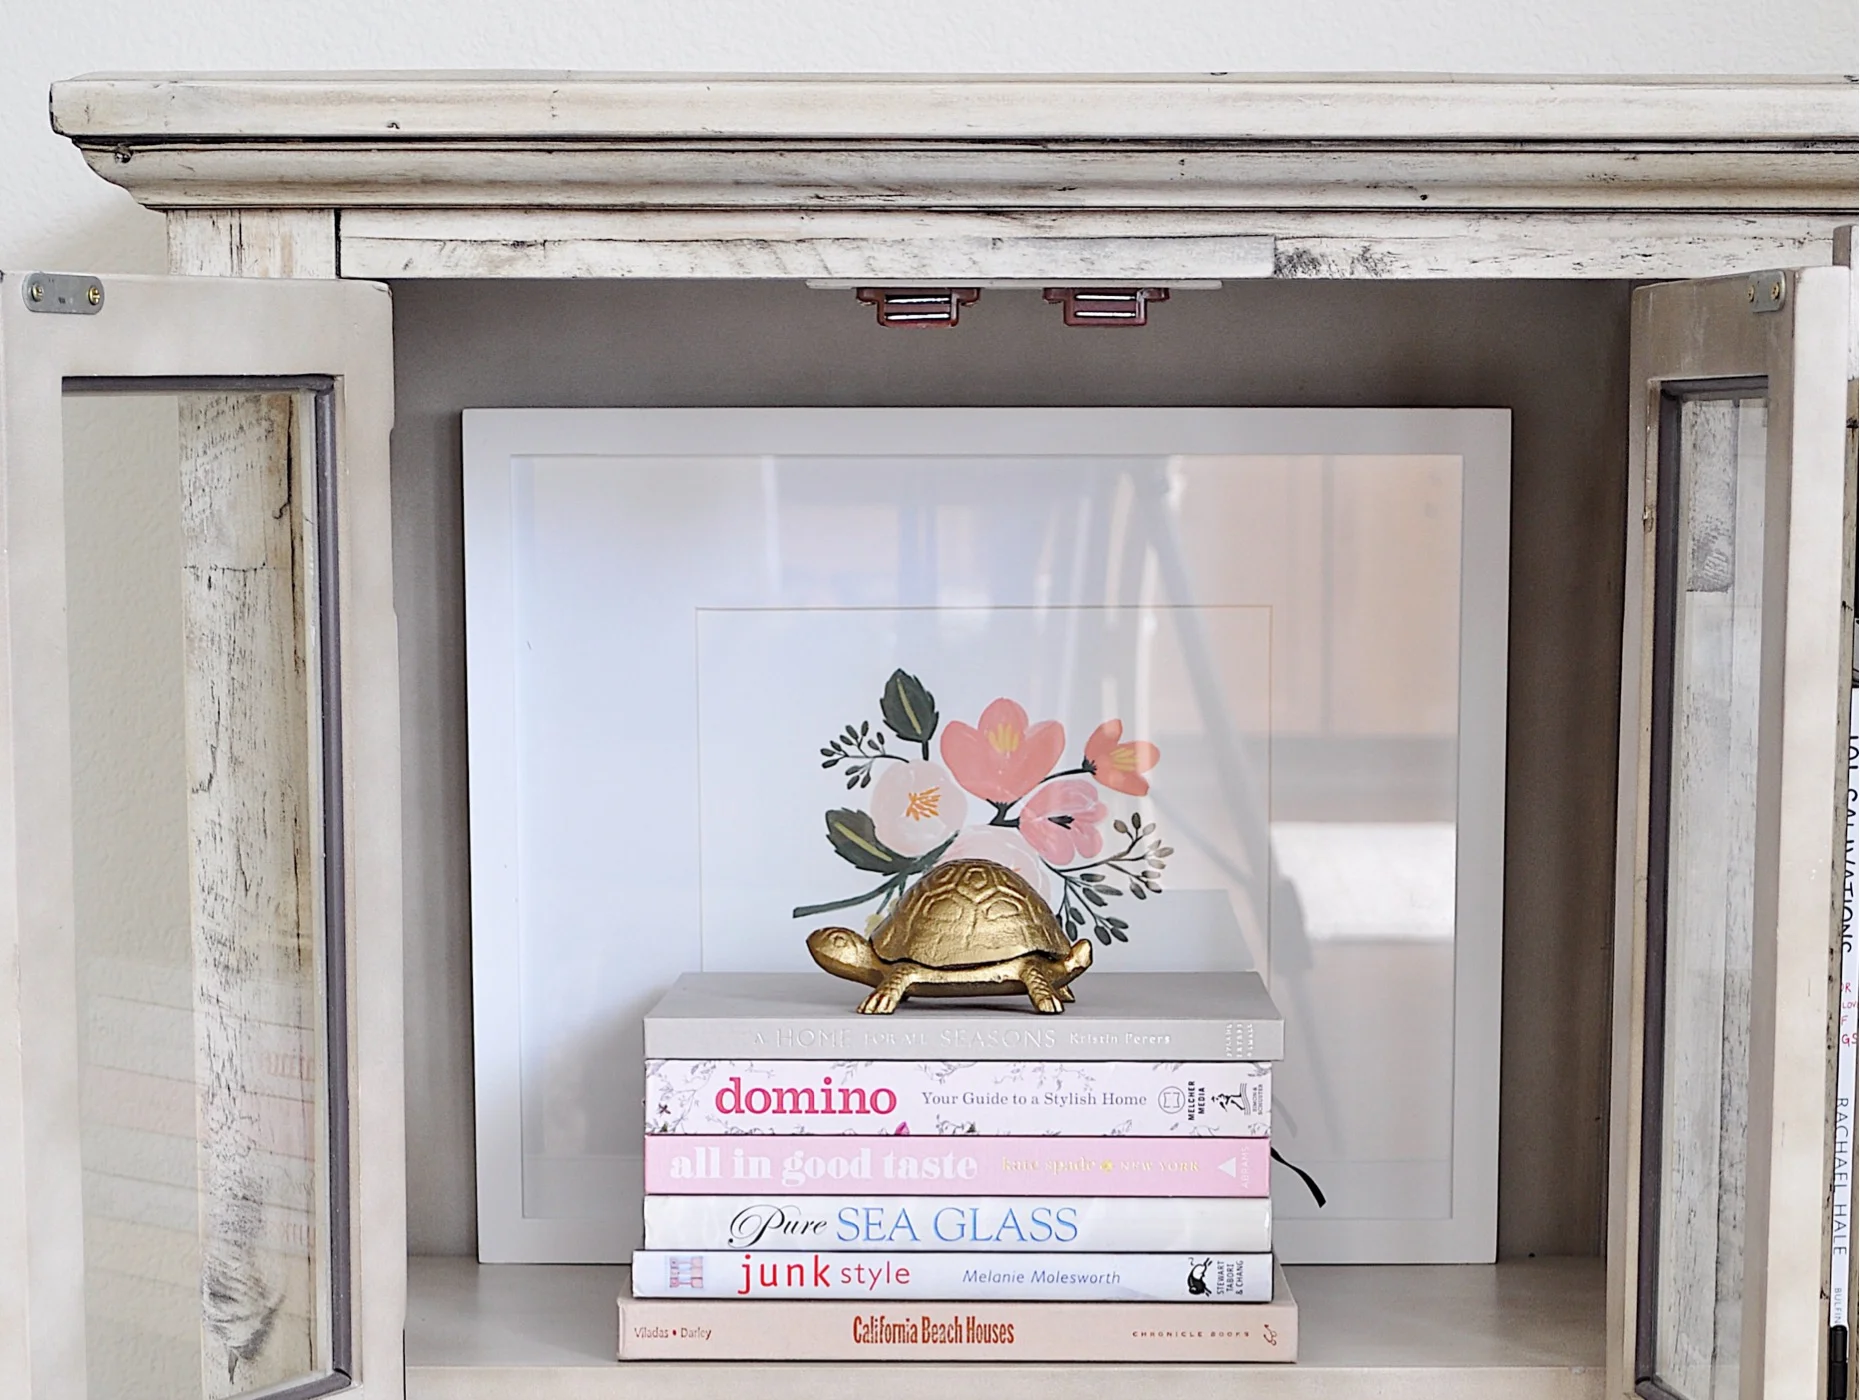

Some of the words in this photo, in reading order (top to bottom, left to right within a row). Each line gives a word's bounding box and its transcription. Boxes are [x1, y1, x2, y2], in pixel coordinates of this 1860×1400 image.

[776, 1029, 851, 1048] HOME
[864, 1032, 896, 1047] FOR
[941, 1029, 1055, 1048] SEASONS
[1069, 1032, 1118, 1045] Kristin
[715, 1077, 897, 1115] domino
[922, 1092, 958, 1105] Your
[963, 1092, 1007, 1106] Guide
[1012, 1094, 1027, 1106] to
[1031, 1096, 1040, 1106] a
[1044, 1092, 1101, 1108] Stylish
[1105, 1093, 1148, 1106] Home
[1188, 1081, 1196, 1120] MELCHER
[1198, 1087, 1206, 1115] MEDIA
[1834, 1098, 1848, 1191] RACHAEL
[670, 1147, 720, 1179] all
[732, 1148, 771, 1179] in
[782, 1148, 871, 1187] good
[882, 1152, 978, 1179] taste
[1002, 1157, 1038, 1171] kate
[1045, 1157, 1095, 1175] spade
[1120, 1161, 1152, 1171] NEW
[1159, 1161, 1200, 1171] YORK
[1241, 1146, 1249, 1189] ABRAMS
[727, 1204, 827, 1248] Pure
[836, 1207, 921, 1242] SEA
[933, 1207, 1078, 1242] GLASS
[1833, 1204, 1847, 1255] HALE
[738, 1254, 831, 1294] junk
[840, 1262, 911, 1290] style
[962, 1269, 1025, 1284] Melanie
[1031, 1269, 1120, 1285] Molesworth
[1226, 1263, 1234, 1292] TABORI
[1236, 1287, 1243, 1295] &
[634, 1327, 669, 1339] Viladas
[680, 1327, 711, 1341] Darley
[853, 1316, 917, 1345] California
[921, 1316, 962, 1345] Beach
[966, 1316, 1015, 1345] Houses
